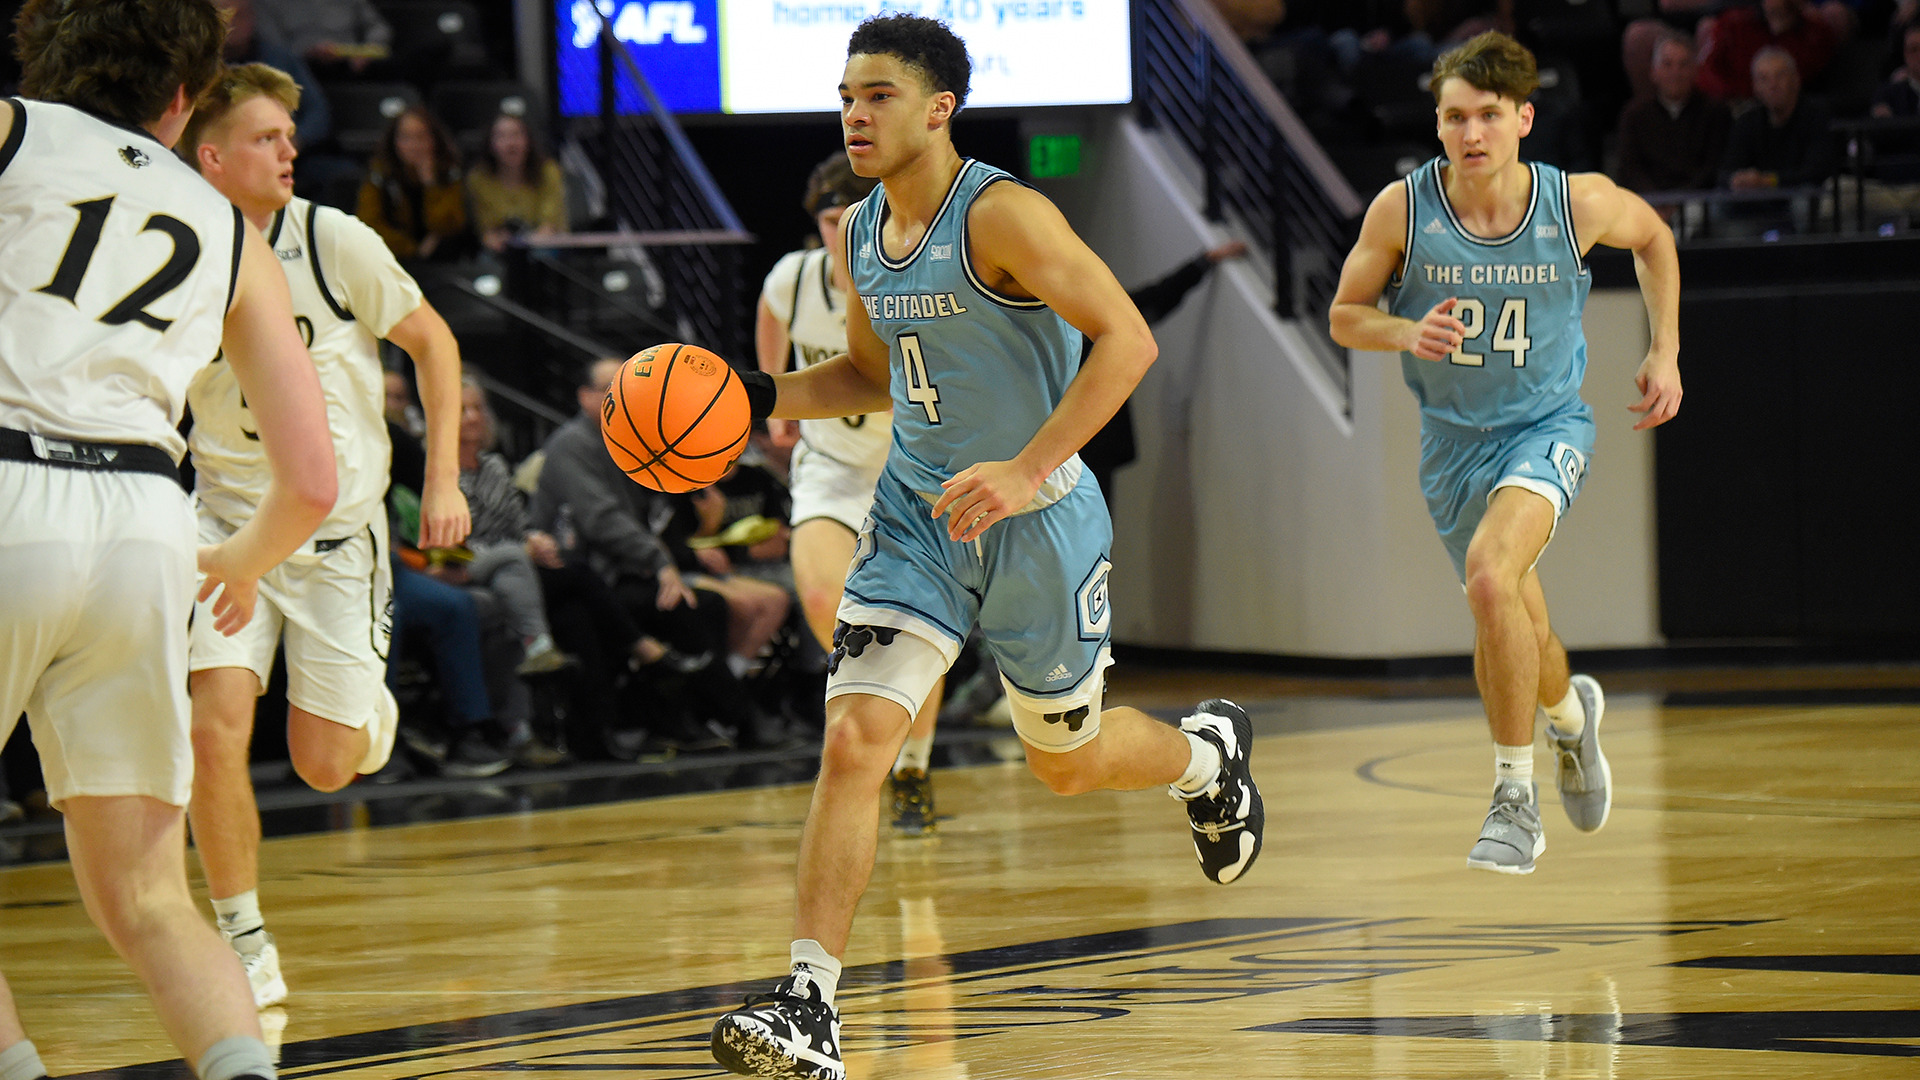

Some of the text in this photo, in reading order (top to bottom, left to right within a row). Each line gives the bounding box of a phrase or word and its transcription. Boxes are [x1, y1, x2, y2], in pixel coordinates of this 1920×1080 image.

[612, 1, 708, 45] AFL
[992, 0, 1084, 28] years
[28, 192, 202, 334] 12
[1423, 262, 1560, 285] THE CITADEL
[859, 291, 968, 320] HE CITADEL
[1450, 297, 1532, 368] 24
[897, 332, 941, 425] 4
